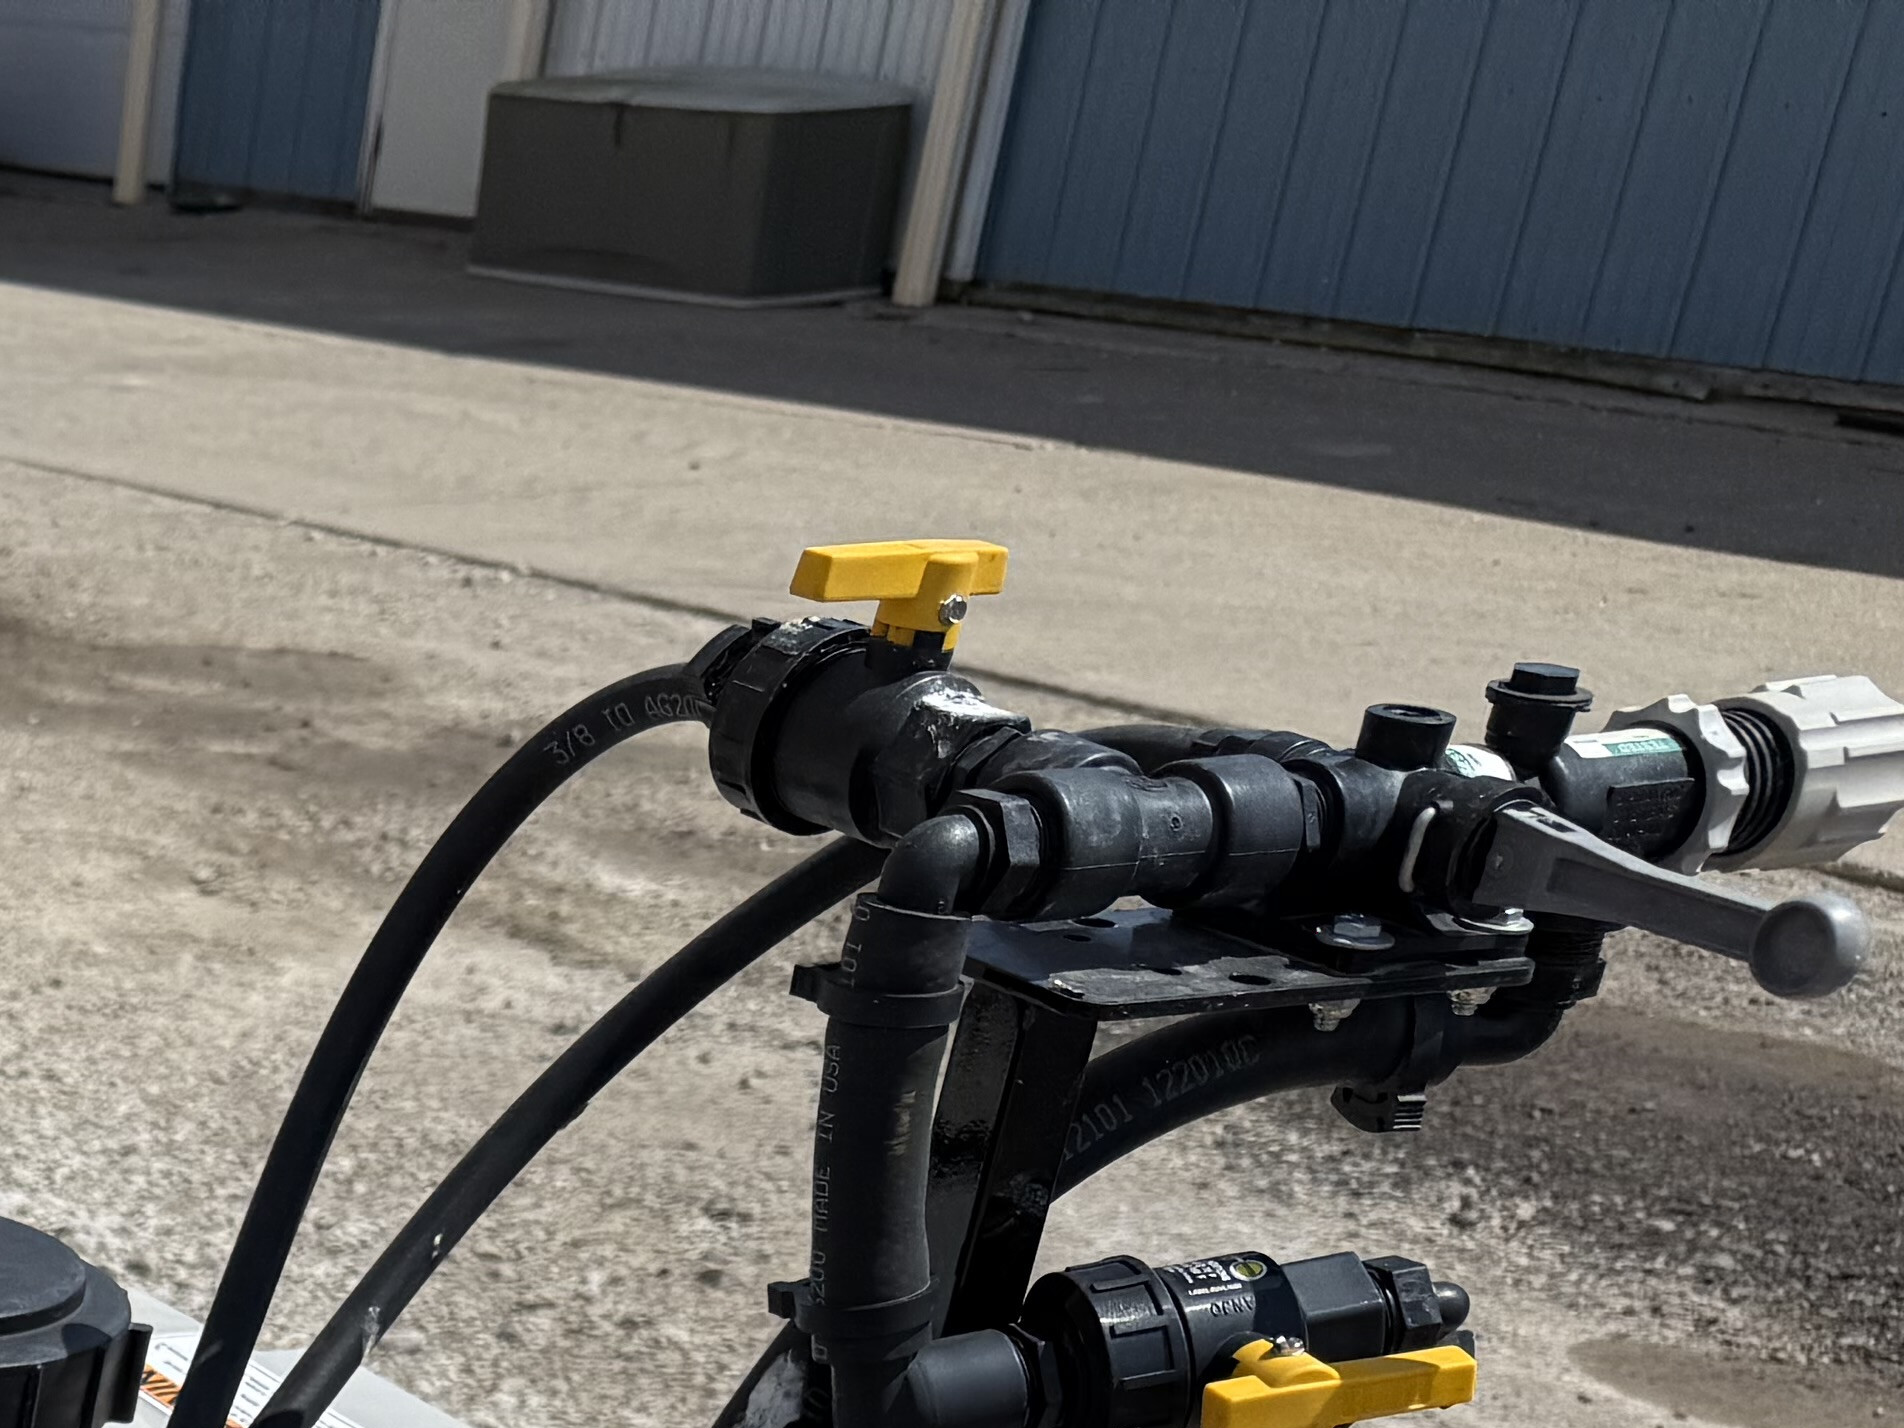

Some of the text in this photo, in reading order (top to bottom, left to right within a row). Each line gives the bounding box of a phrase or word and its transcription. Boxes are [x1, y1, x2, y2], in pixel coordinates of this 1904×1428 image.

[543, 724, 595, 764] 3/8
[601, 702, 635, 731] ID
[824, 1043, 841, 1094] USA
